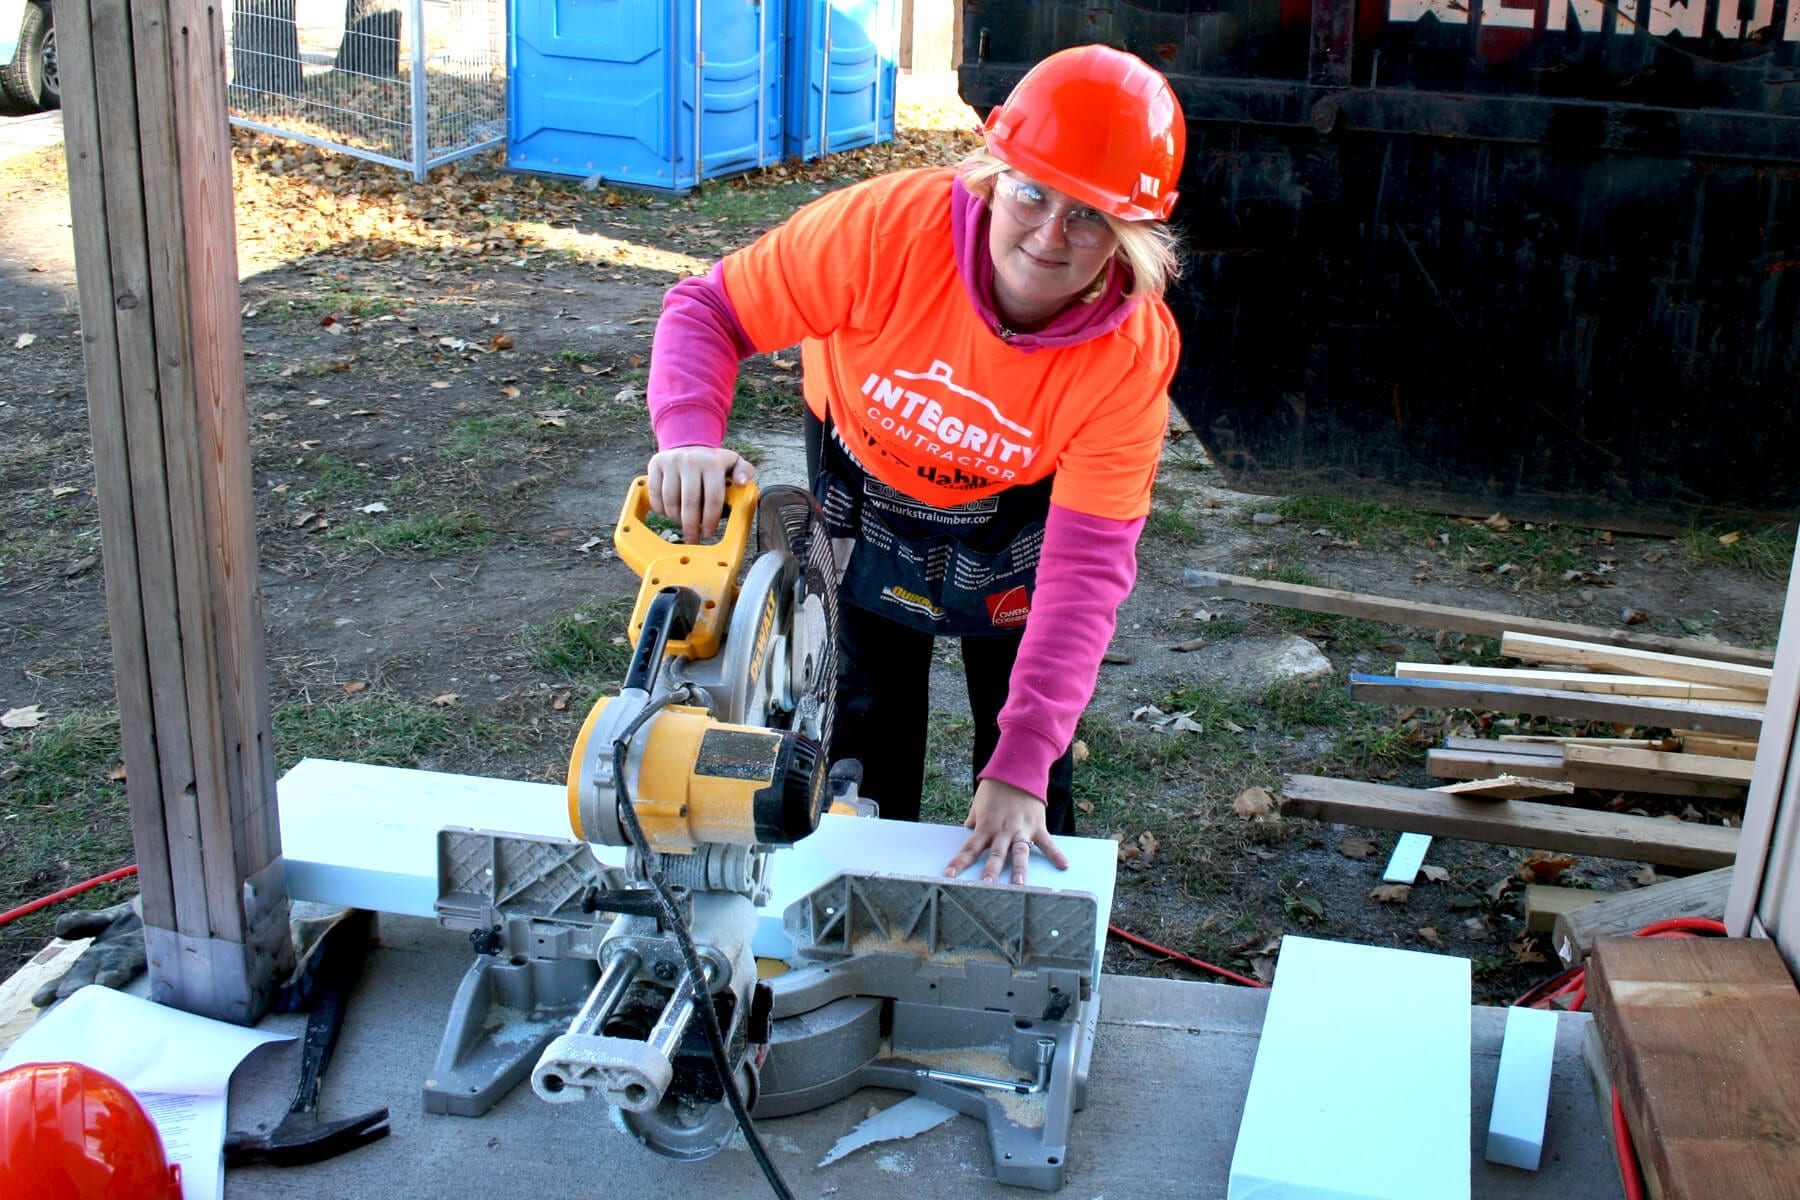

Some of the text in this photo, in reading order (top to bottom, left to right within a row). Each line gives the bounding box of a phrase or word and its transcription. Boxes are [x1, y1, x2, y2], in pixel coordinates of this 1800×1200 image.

[861, 373, 1042, 468] INTEGRITY
[867, 407, 1016, 481] CONTRACTOR
[1000, 607, 1029, 619] OWENS
